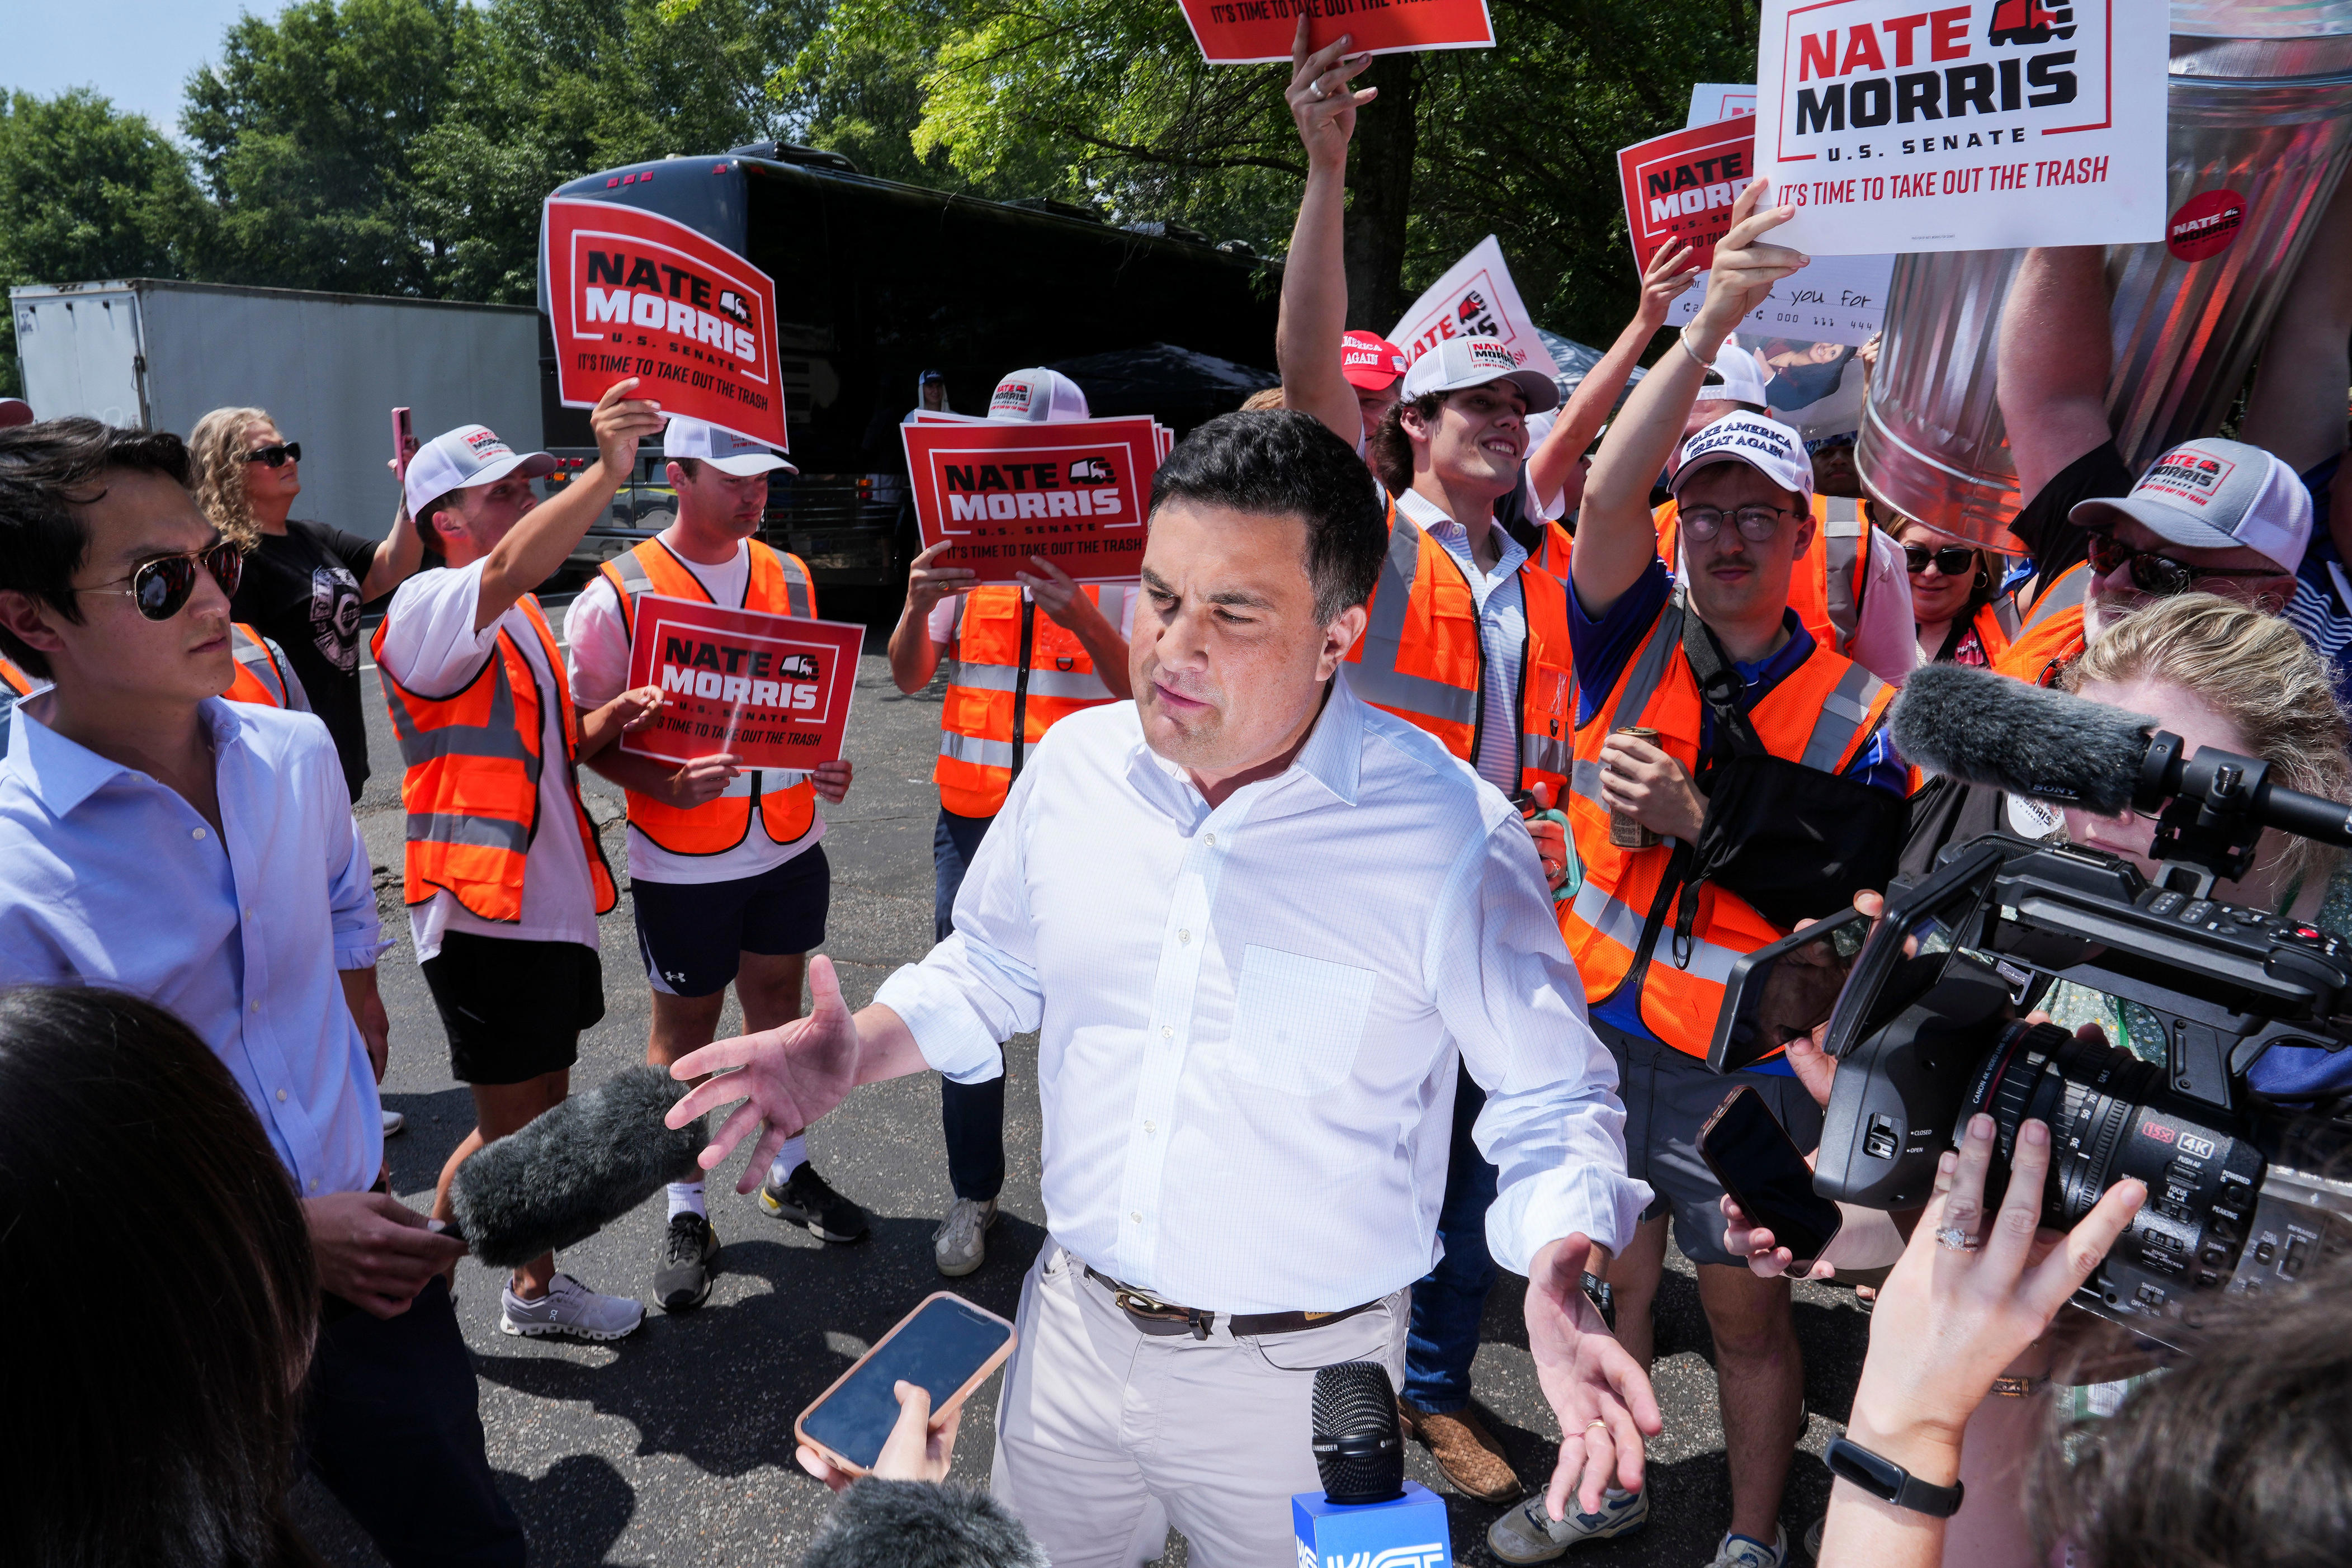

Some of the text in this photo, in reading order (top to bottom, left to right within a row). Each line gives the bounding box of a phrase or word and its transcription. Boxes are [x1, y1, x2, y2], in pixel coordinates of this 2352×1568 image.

[1211, 5, 1236, 24] IT'S
[1238, 2, 1270, 22] TIME
[1274, 1, 1288, 18] TO
[1798, 4, 1972, 83] NATE
[1796, 49, 2078, 136] MORRIS
[1829, 127, 2025, 162] U.S. SENATE
[1647, 152, 1744, 197] NATE
[1778, 155, 2109, 207] IT'S TIME TO TAKE OUT THE TRASH
[1672, 220, 1702, 232] U.S.
[2173, 213, 2221, 235] NATE
[2174, 217, 2241, 245] MORRIS
[1690, 235, 1704, 248] TO
[588, 251, 711, 310] NATE
[1791, 289, 1824, 306] you
[585, 287, 755, 362] MORRIS
[1777, 313, 1798, 323] 000
[1851, 320, 1872, 330] 444
[612, 332, 735, 372] U.S. SENATE
[1344, 352, 1378, 366] AGAIN
[578, 353, 768, 411] IT'S TIME TO TAKE OUT THE TRASH
[1724, 423, 1792, 450] AMERICA
[1690, 435, 1784, 459] GREAT AGAIN
[944, 463, 1060, 491] NATE
[948, 488, 1121, 521] MORRIS
[978, 523, 1097, 536] U.S. SENATE
[947, 538, 1141, 559] IT'S TIME TO TAKE OUT THE TRASH
[664, 637, 772, 677] NATE
[662, 664, 818, 709] MORRIS
[679, 701, 788, 723] U.S. SENATE
[667, 717, 693, 733] TIME
[694, 723, 709, 737] TO
[712, 725, 740, 742] TAKE
[742, 731, 764, 743] OUT
[767, 731, 787, 745] THE
[788, 733, 821, 746] TRASH
[2033, 784, 2077, 795] SONY
[1973, 1080, 1986, 1103] CANON
[1986, 1054, 1998, 1071] VIDEO
[1995, 1042, 2005, 1054] LENS
[2087, 1094, 2098, 1104] 70
[2081, 1109, 2091, 1120] 50
[2070, 1137, 2080, 1149] 30
[2183, 1137, 2207, 1155] 4K
[2178, 1155, 2193, 1165] PUSH
[2222, 1169, 2251, 1184] POWERED
[2169, 1186, 2188, 1197] FOCUS
[2212, 1205, 2239, 1220] PEAKING
[2260, 1236, 2278, 1245] AUTO
[2264, 1230, 2277, 1239] FULL
[2287, 1224, 2317, 1239] INFRARED
[2151, 1249, 2168, 1258] ZOOM
[2207, 1241, 2226, 1253] ZEBRA
[2142, 1249, 2184, 1269] RING ROCKER
[2141, 1282, 2165, 1296] SHUTTER
